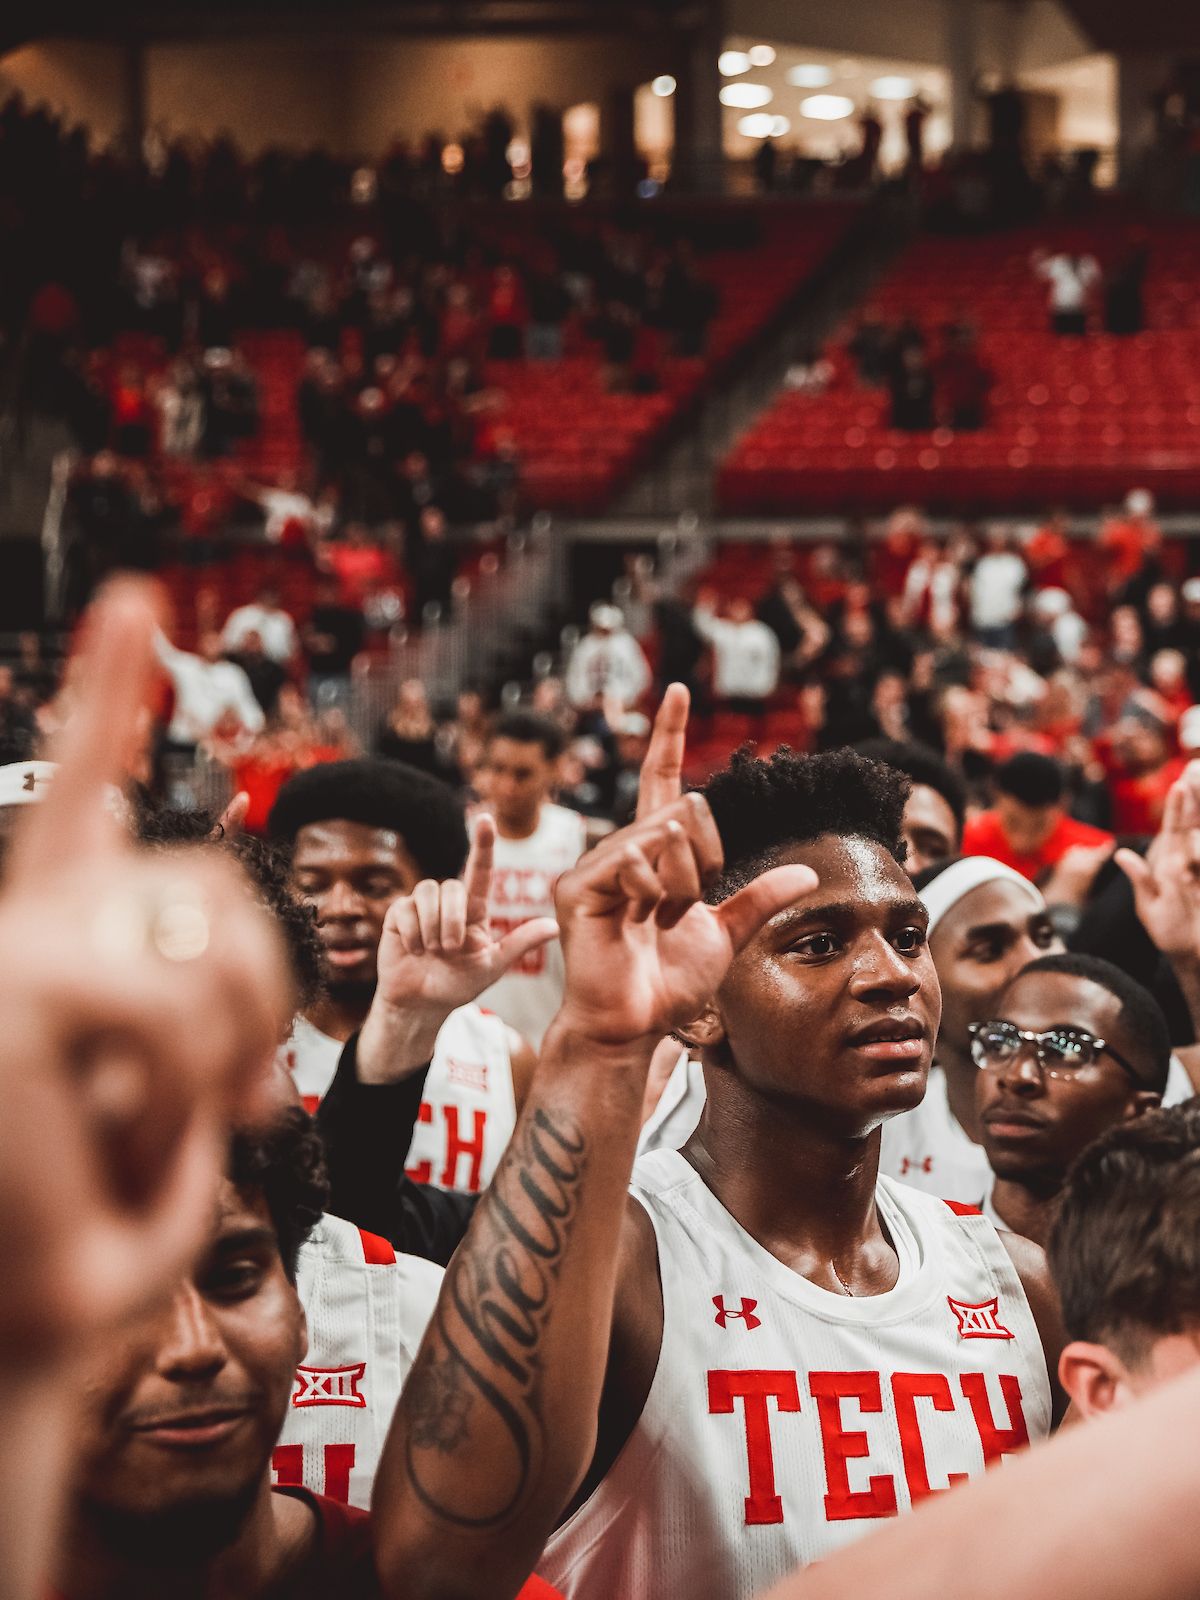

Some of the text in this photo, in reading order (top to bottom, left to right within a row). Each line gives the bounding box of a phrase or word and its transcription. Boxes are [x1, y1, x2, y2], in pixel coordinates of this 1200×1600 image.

[948, 1297, 1013, 1338] XII
[294, 1364, 366, 1407] XII
[707, 1369, 1031, 1525] TECH
